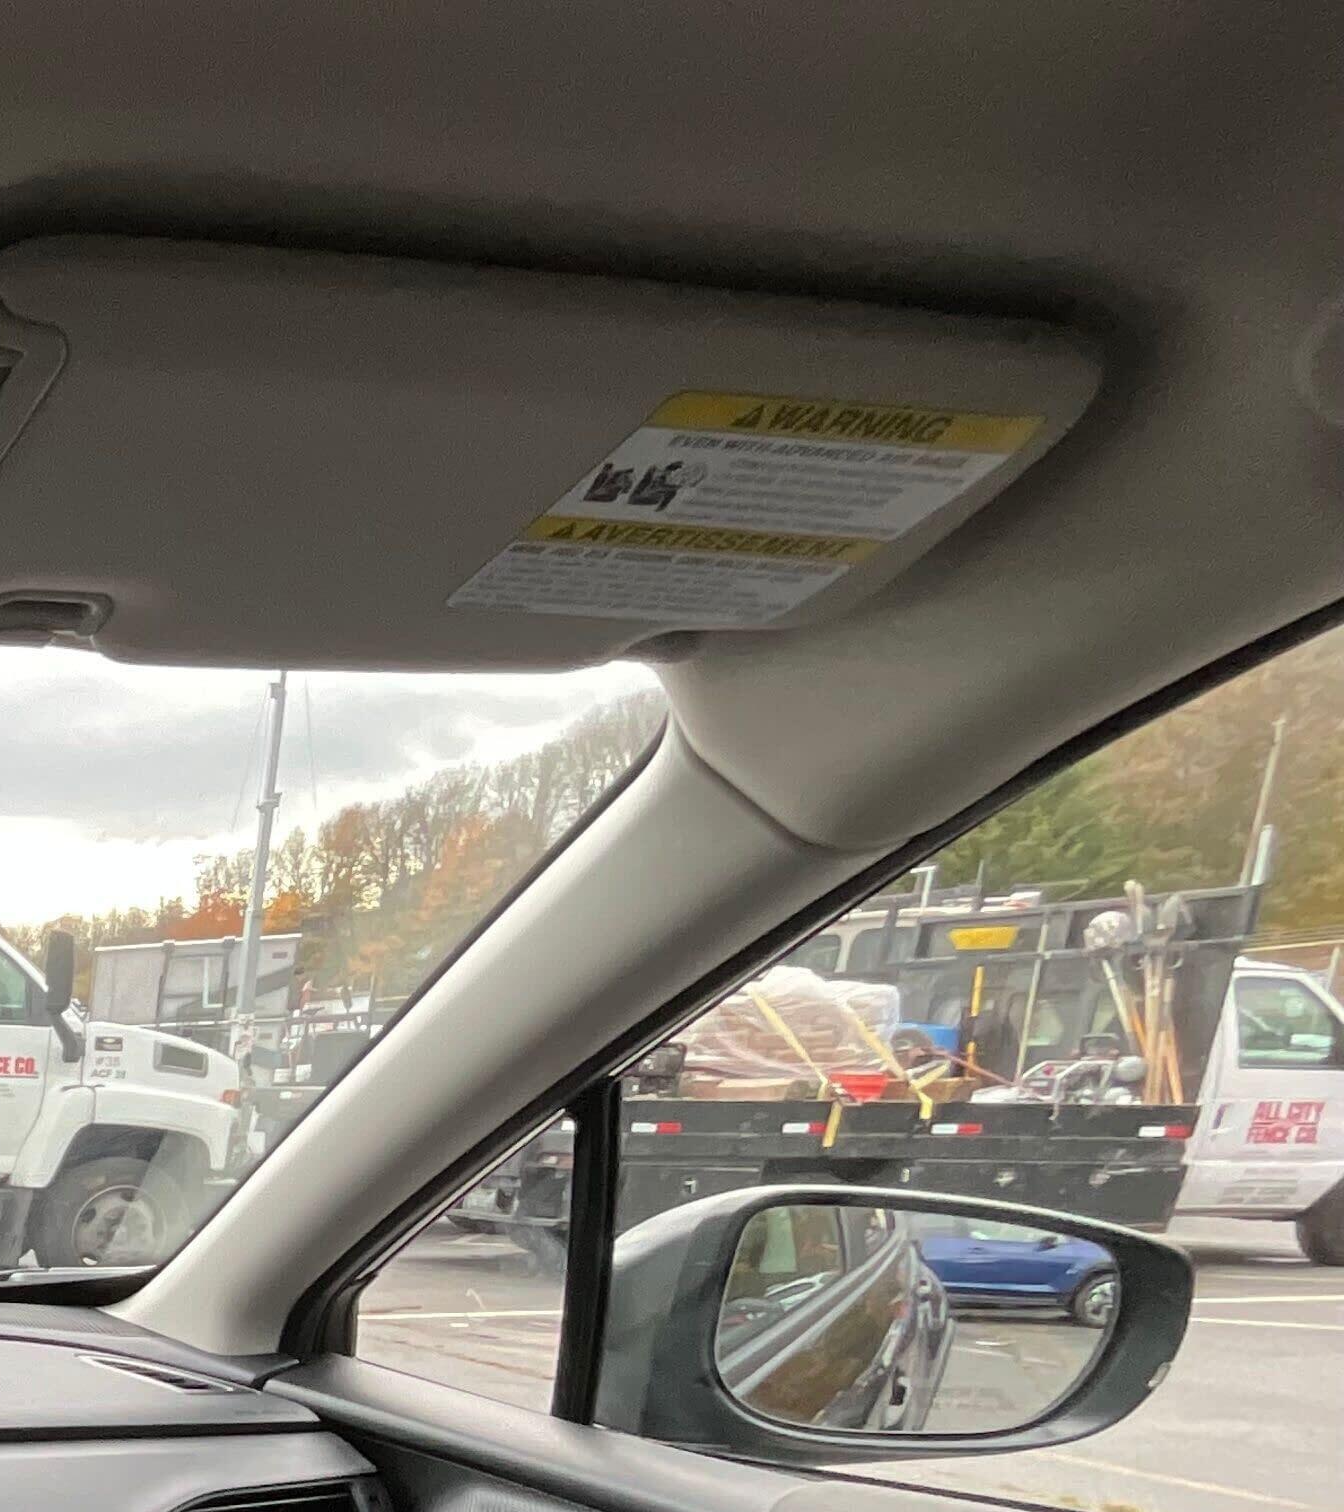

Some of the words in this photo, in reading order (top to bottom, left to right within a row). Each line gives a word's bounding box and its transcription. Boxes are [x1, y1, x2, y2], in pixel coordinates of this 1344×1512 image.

[767, 403, 954, 444] WARNING
[578, 523, 853, 559] AVERTISSEMENT
[15, 1056, 39, 1075] CO.
[1253, 1101, 1282, 1121] ALL
[1287, 1102, 1325, 1122] CITY
